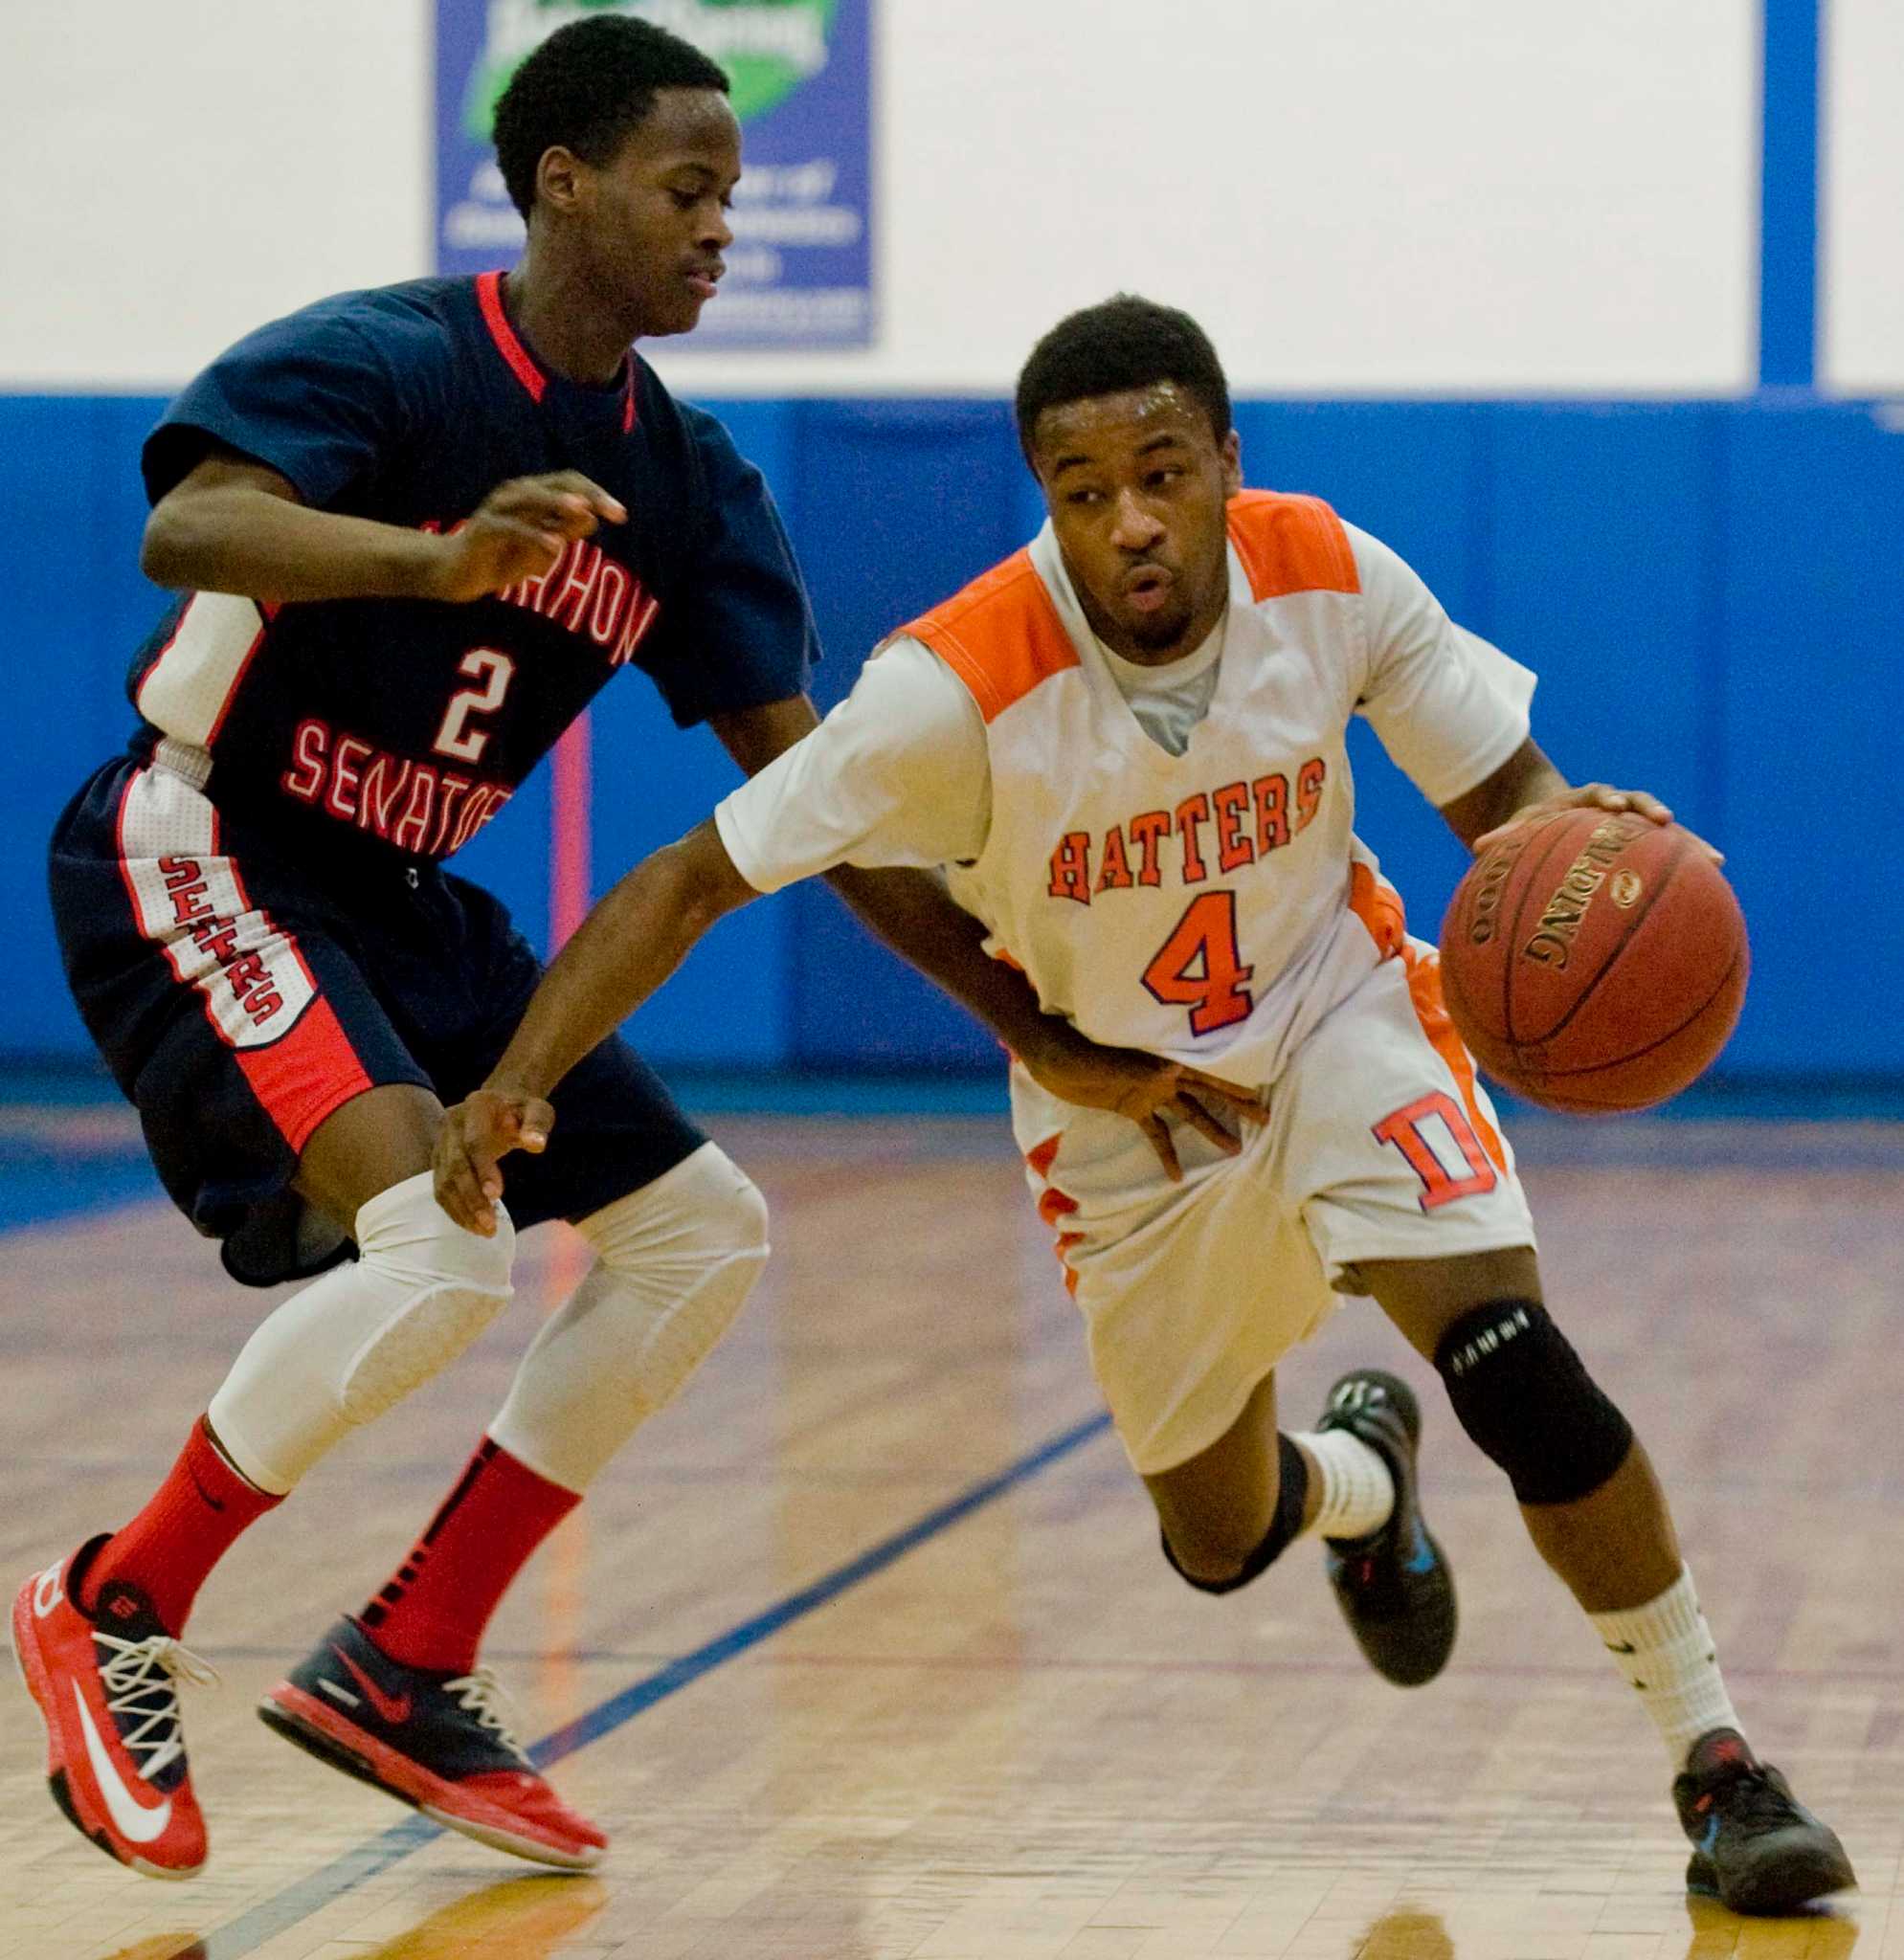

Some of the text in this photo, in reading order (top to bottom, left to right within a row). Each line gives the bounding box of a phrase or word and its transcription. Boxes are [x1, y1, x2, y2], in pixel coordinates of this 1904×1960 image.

[433, 646, 519, 765] 2
[1047, 756, 1326, 906] HATTERS
[1140, 890, 1255, 1037] 4
[1371, 1090, 1498, 1215] D
